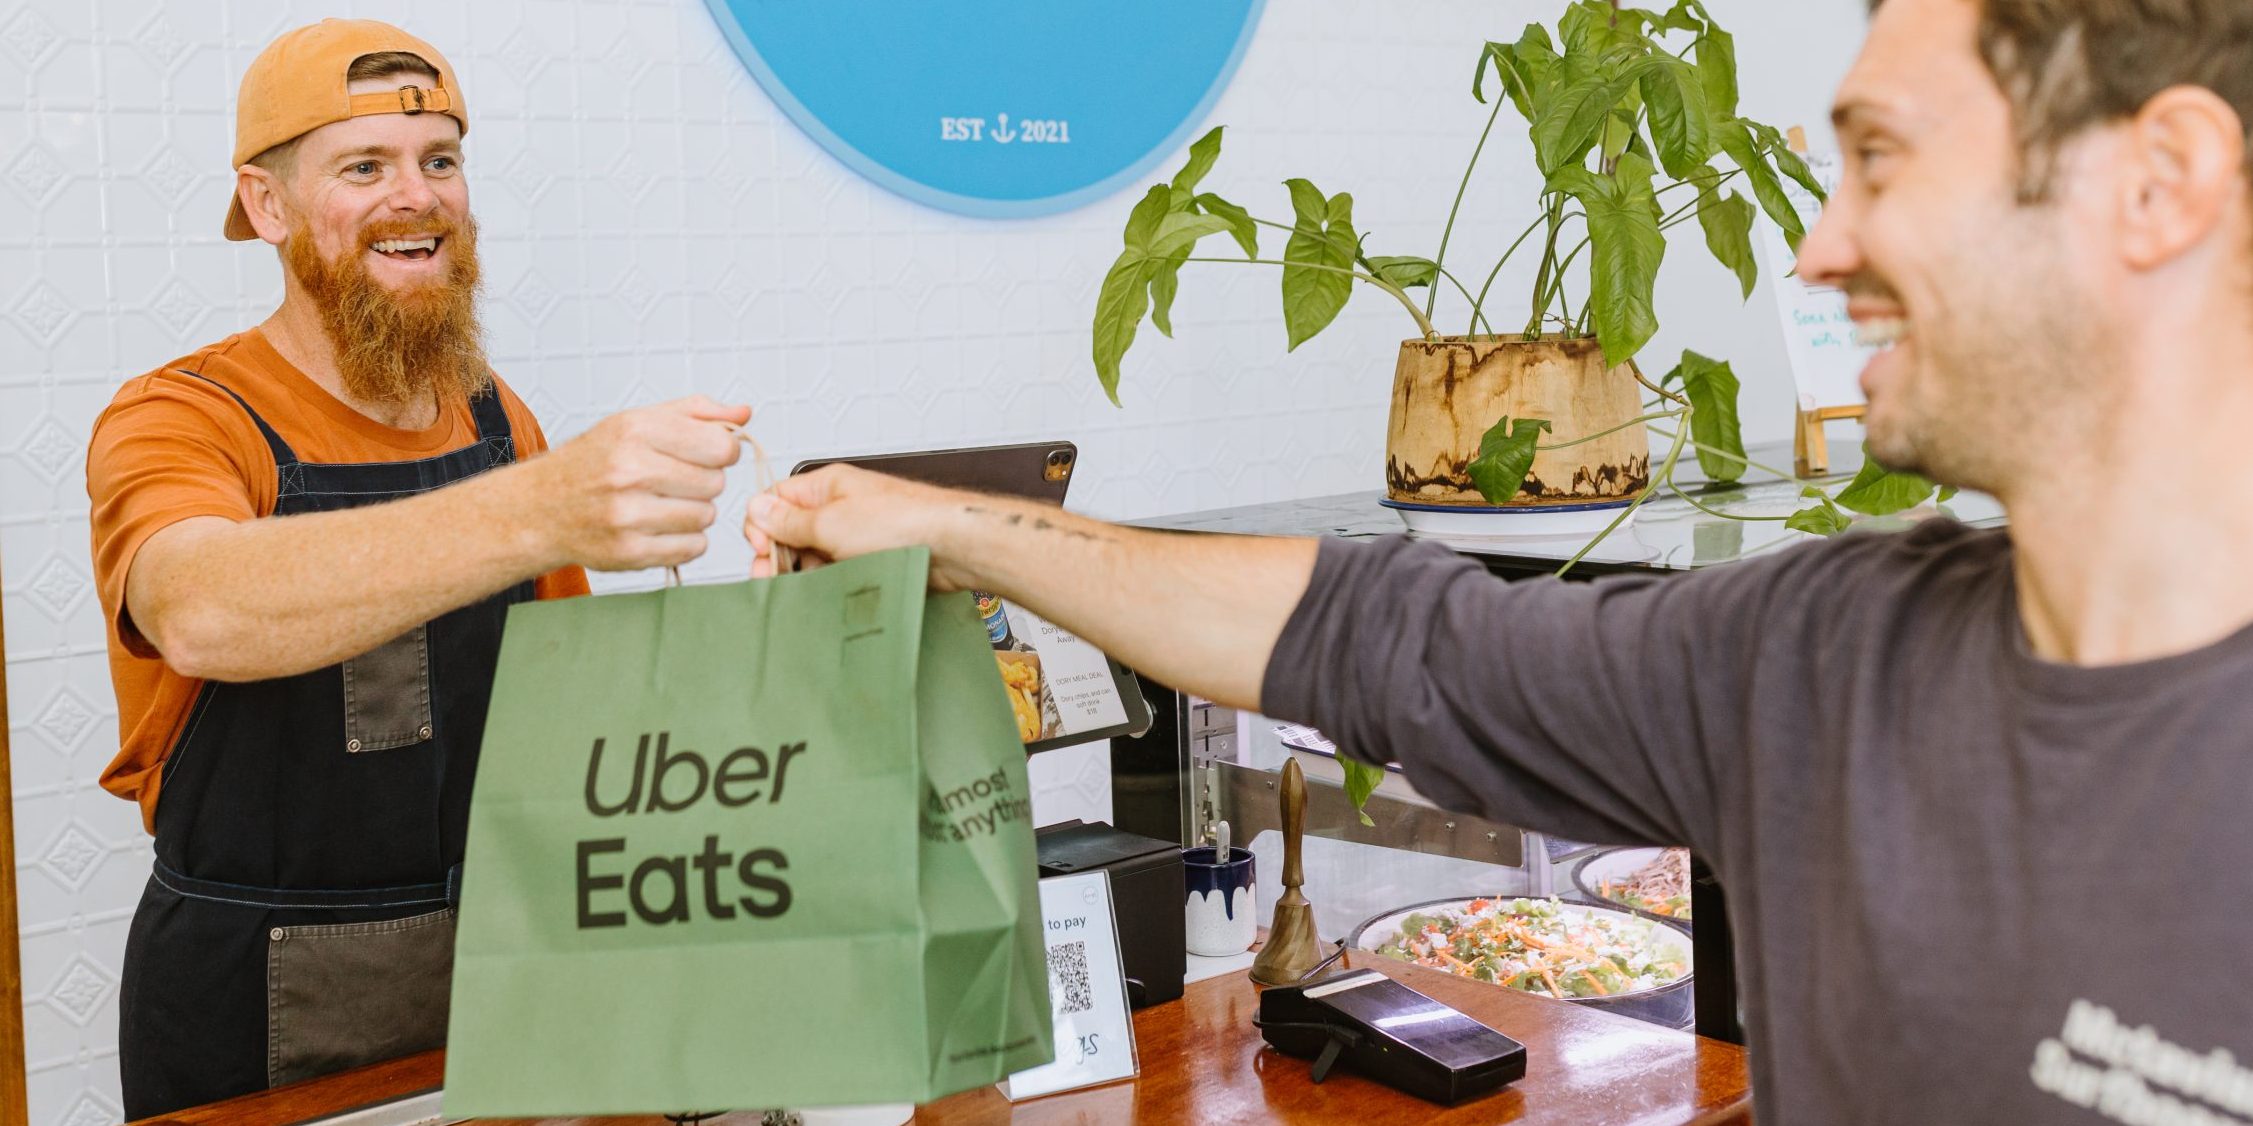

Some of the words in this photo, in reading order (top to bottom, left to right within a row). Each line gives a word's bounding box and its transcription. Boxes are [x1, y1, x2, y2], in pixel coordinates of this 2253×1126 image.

[941, 117, 985, 141] EST
[1020, 119, 1070, 143] 2021
[585, 731, 808, 819] Uber
[576, 834, 793, 930] Eats
[1048, 919, 1061, 930] to
[1064, 916, 1086, 931] pay
